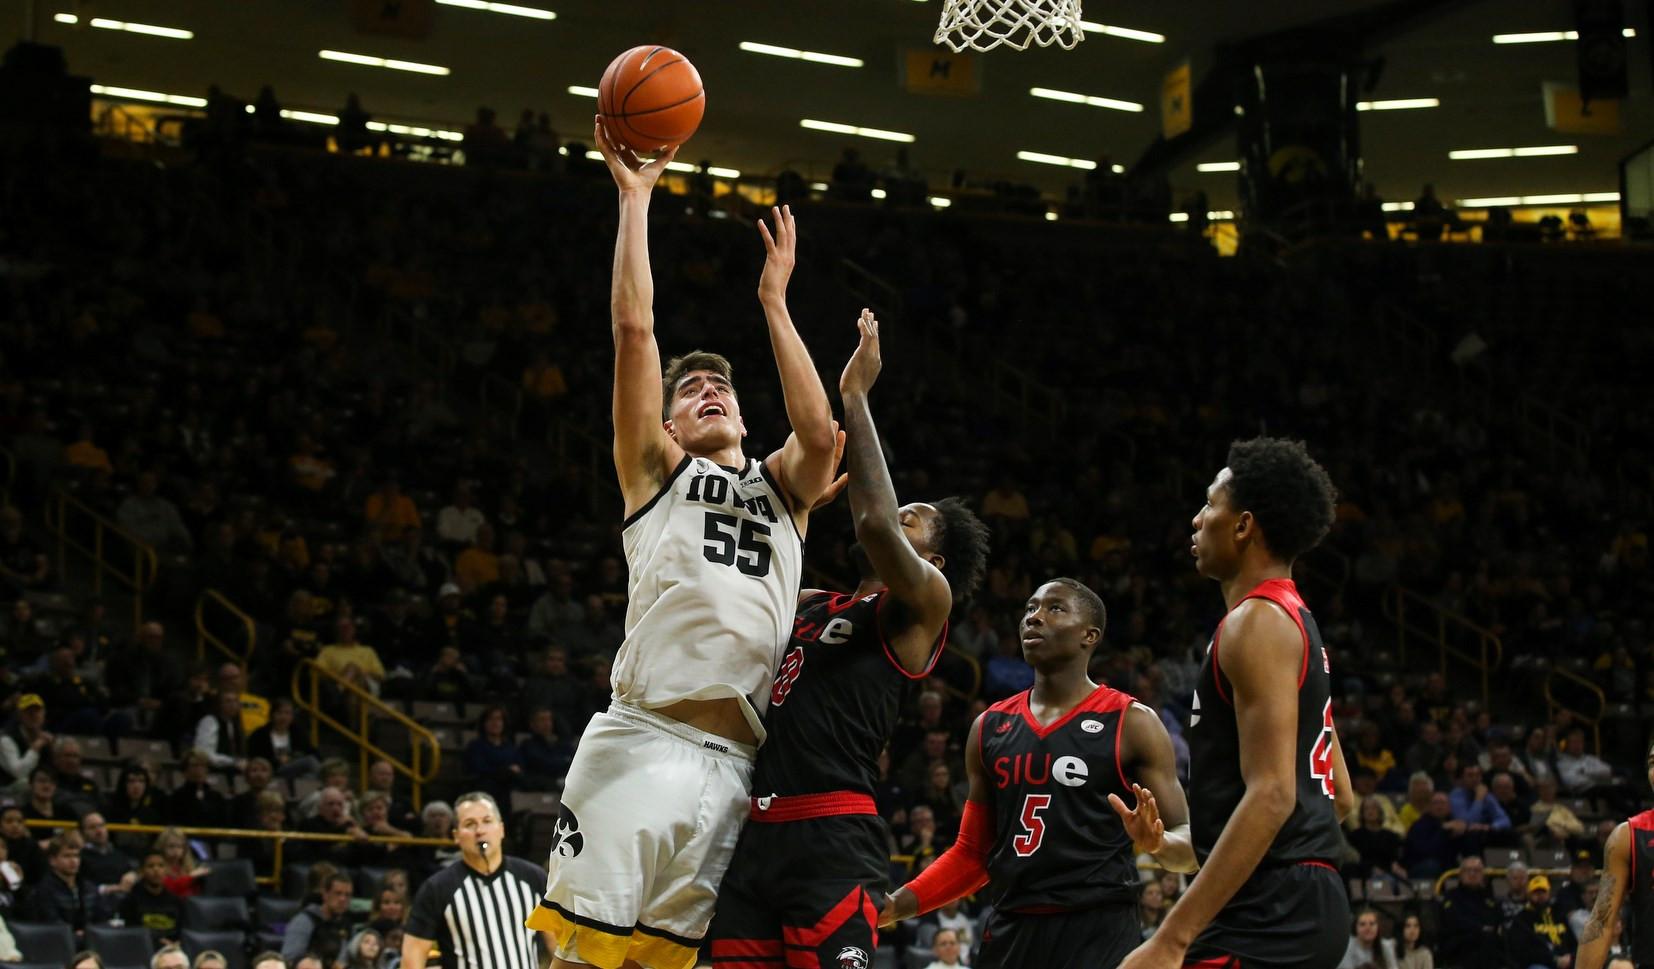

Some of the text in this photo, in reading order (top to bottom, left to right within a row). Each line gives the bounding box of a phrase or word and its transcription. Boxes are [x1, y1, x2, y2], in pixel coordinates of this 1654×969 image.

[703, 511, 772, 578] 55
[703, 740, 729, 753] HAWKS
[1013, 794, 1052, 857] 5
